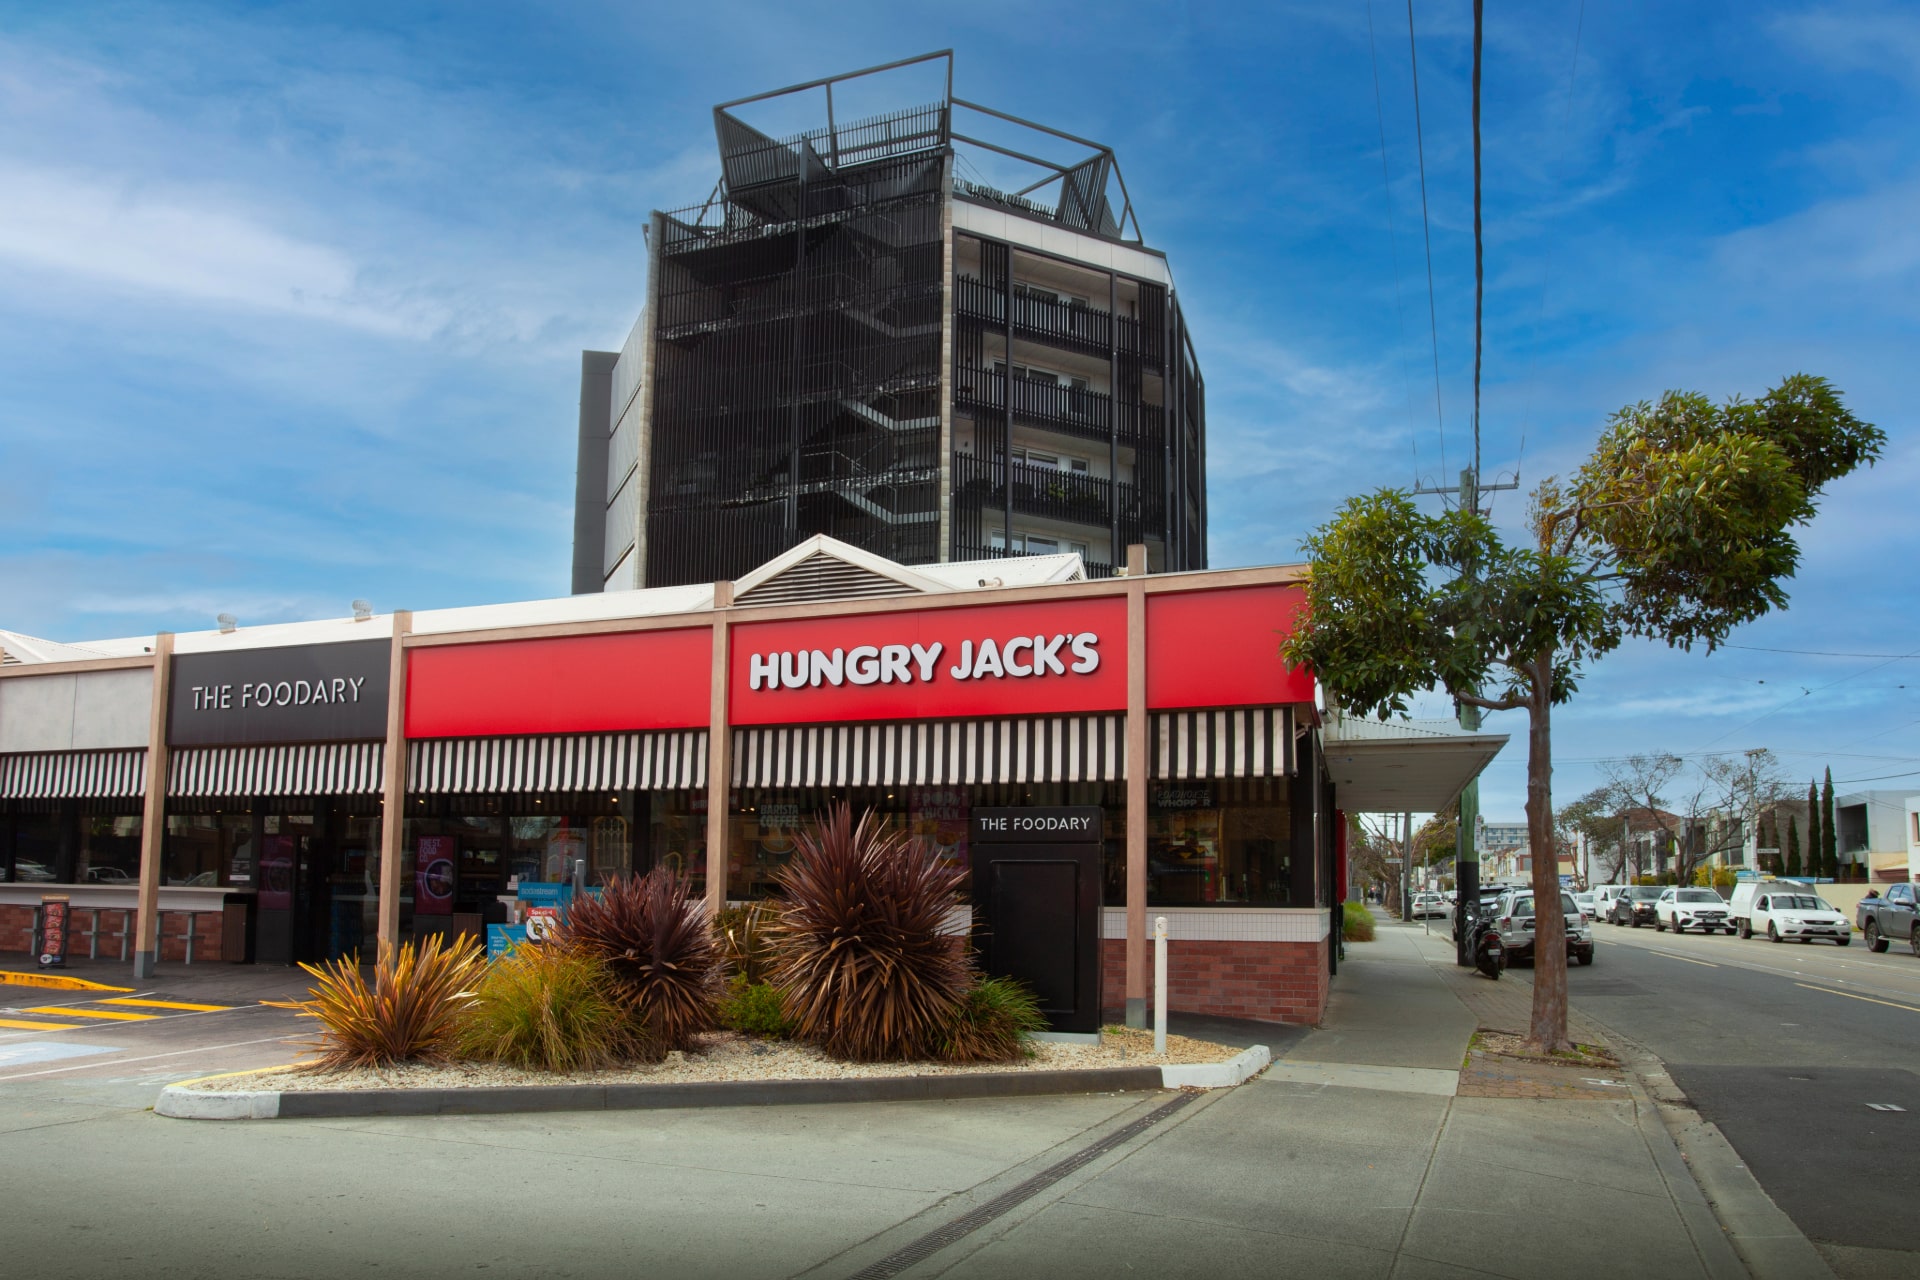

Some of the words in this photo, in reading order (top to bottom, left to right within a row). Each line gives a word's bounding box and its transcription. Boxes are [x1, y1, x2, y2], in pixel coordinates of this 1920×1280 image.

[749, 641, 943, 691] HUNGRY
[950, 631, 1100, 681] JACK'S
[191, 684, 232, 710] THE
[242, 676, 364, 708] FOODARY
[760, 804, 799, 815] BARISTA
[1157, 798, 1211, 808] WHOPPR
[760, 814, 799, 828] COFFEE
[980, 818, 1007, 831] THE
[1013, 817, 1090, 831] FOODARY
